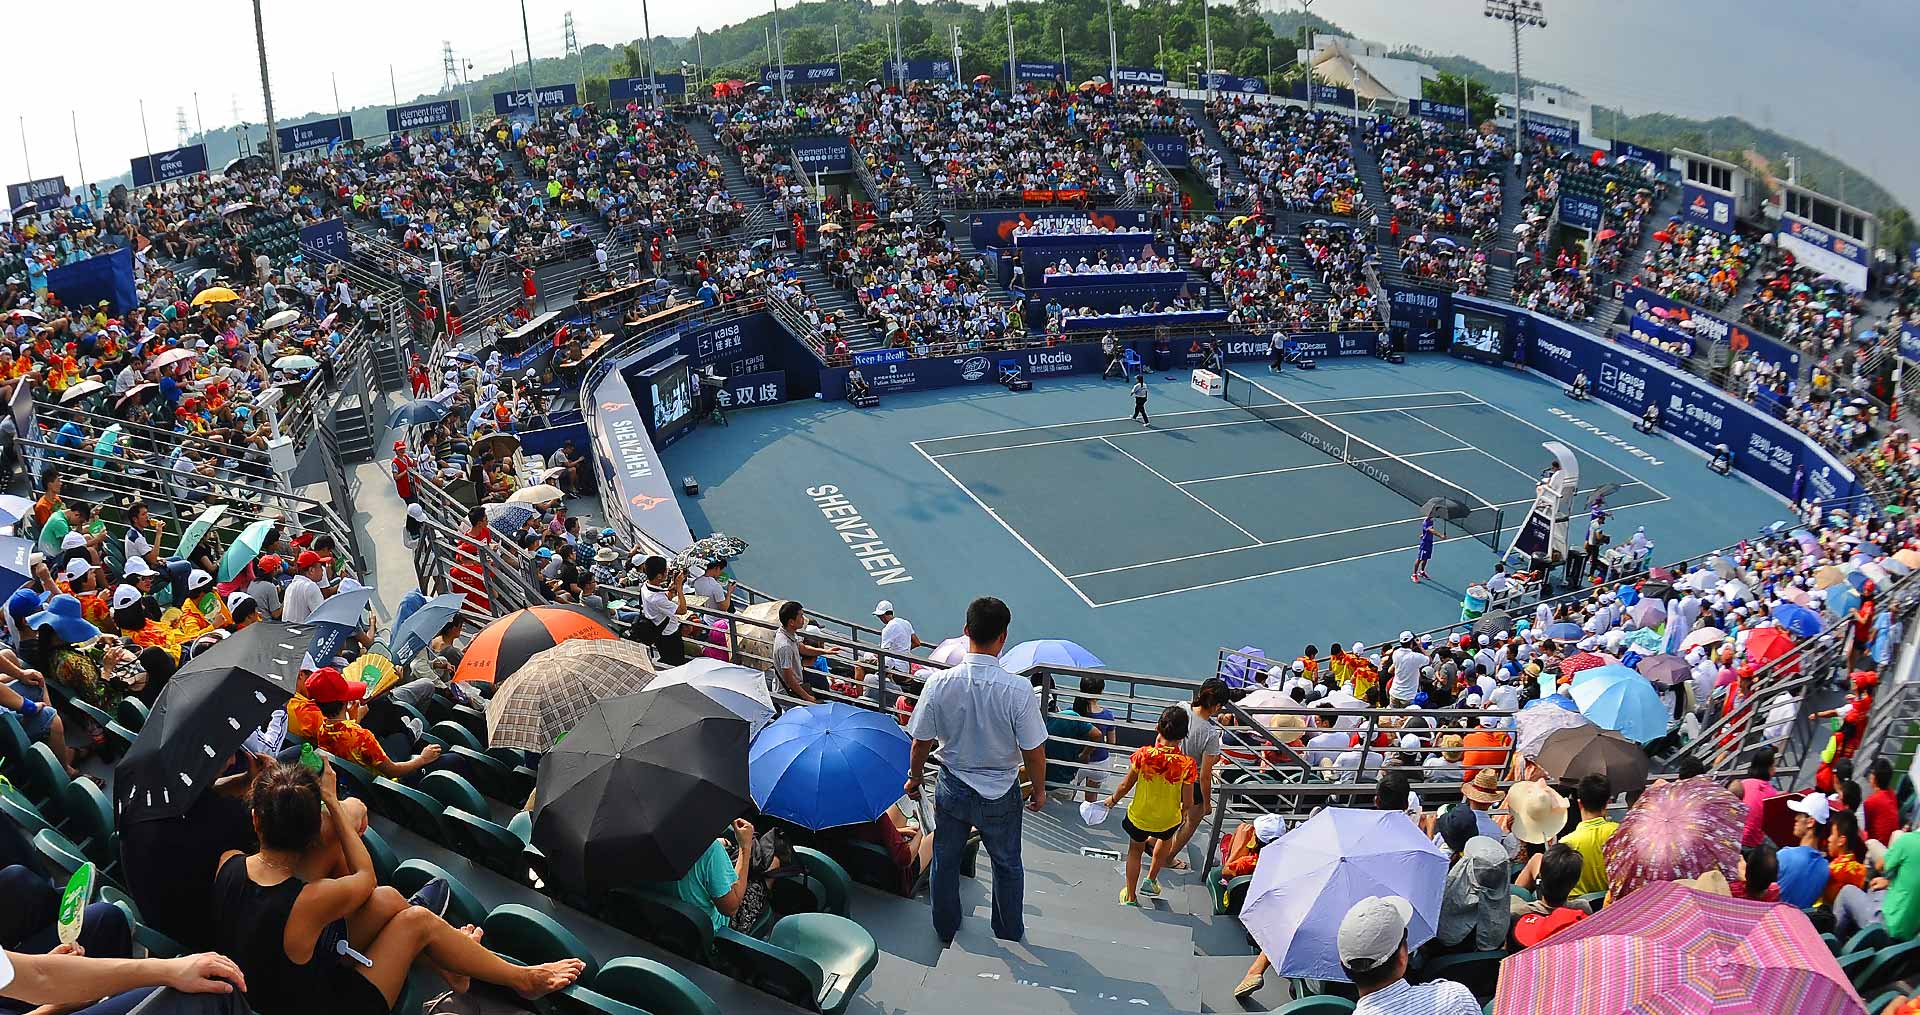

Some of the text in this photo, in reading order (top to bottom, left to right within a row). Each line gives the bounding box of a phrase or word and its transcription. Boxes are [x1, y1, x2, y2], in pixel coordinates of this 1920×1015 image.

[1110, 70, 1163, 82] HEAD
[400, 104, 447, 120] element fresh
[798, 146, 846, 157] element fresh
[1147, 144, 1183, 152] UBER
[305, 231, 344, 250] UBER
[1394, 291, 1438, 308] 金地集团
[714, 324, 740, 340] Kaisa
[715, 335, 741, 351] 佳兆业
[1227, 342, 1255, 353] Letv
[855, 356, 875, 364] Keep
[885, 351, 904, 360] Real!
[1028, 351, 1072, 365] U Radio
[1192, 375, 1210, 390] FedEx
[1619, 371, 1646, 390] Kaisa
[717, 383, 778, 407] 金双歧
[1548, 408, 1665, 466] SHENZHEN
[612, 419, 653, 479] SHENZHEN
[1300, 431, 1391, 484] ATP WORLD TOUR
[806, 484, 913, 586] SHENZHEN
